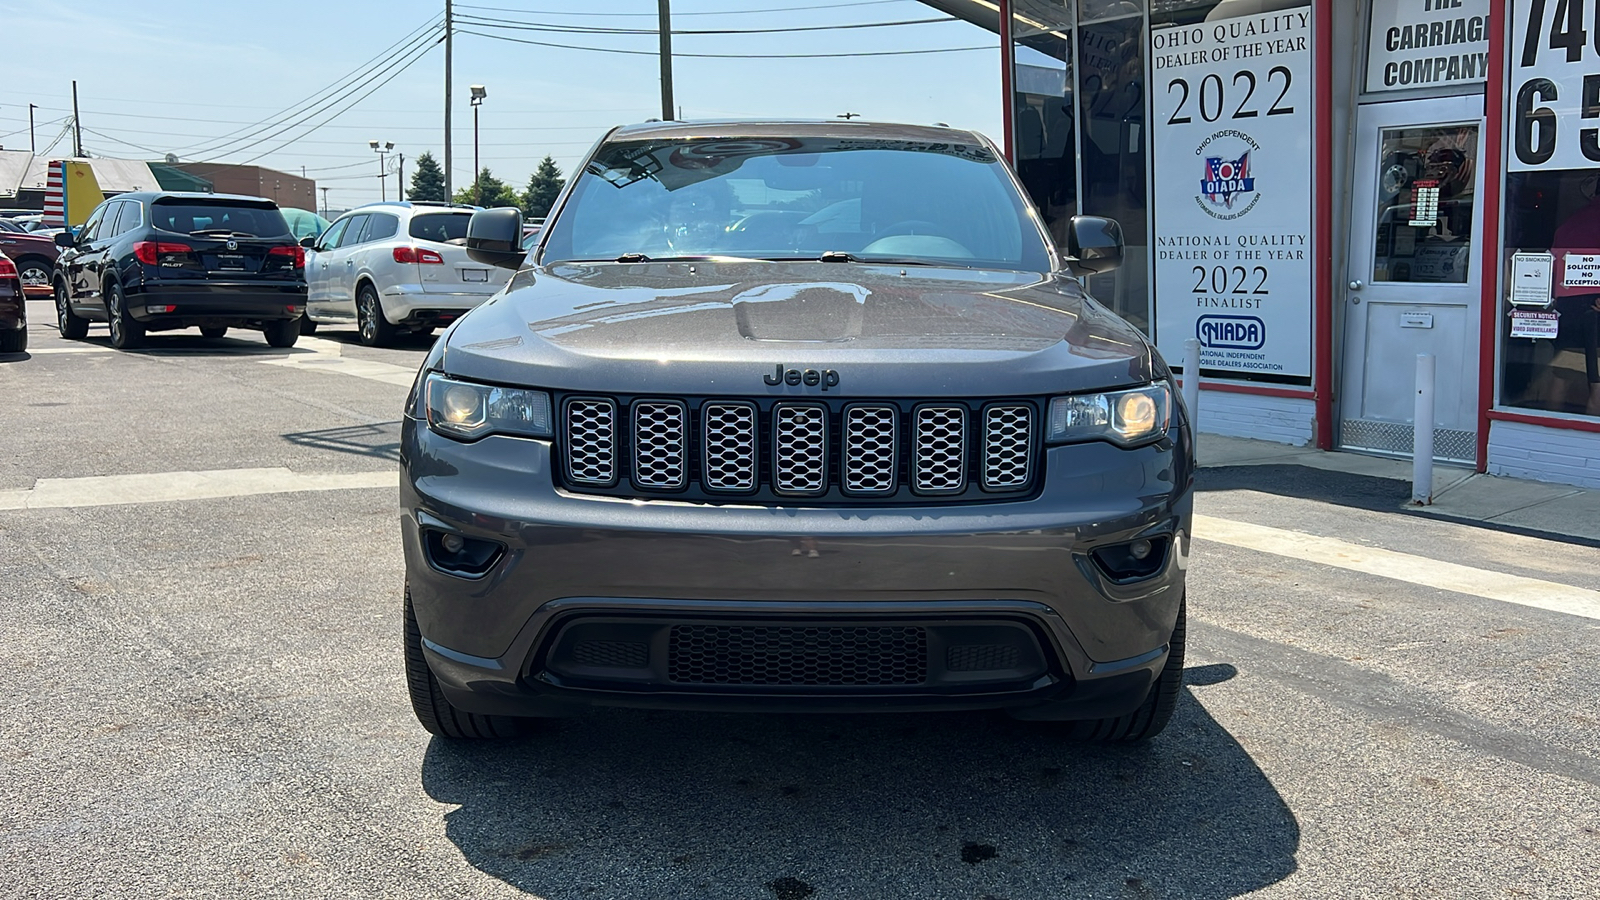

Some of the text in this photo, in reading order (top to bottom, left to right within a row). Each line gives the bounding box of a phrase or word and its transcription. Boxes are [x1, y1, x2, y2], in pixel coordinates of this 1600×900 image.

[1154, 11, 1310, 50] OHIO QUALITY
[1520, 0, 1600, 67] 74
[1156, 36, 1307, 70] DEALER OF THE YEAR
[1384, 52, 1489, 87] COMPANY
[1167, 65, 1294, 125] 2022
[1195, 129, 1261, 156] OHIO INDEPENDENT
[1206, 179, 1246, 193] OIADA
[1195, 192, 1262, 221] AUTOMOBILE DEALERS ASSOCIATION
[1158, 234, 1306, 248] NATIONAL QUALITY
[1159, 250, 1304, 260] DEALER OF THE YEAR
[1191, 265, 1269, 295] 2022
[1197, 297, 1262, 309] FINALIST
[1201, 322, 1258, 345] NIADA
[1217, 359, 1241, 368] DEALERS
[1242, 361, 1283, 371] ASSOCIATION
[1226, 352, 1265, 360] INDEPENDENT
[763, 363, 840, 391] Jeep
